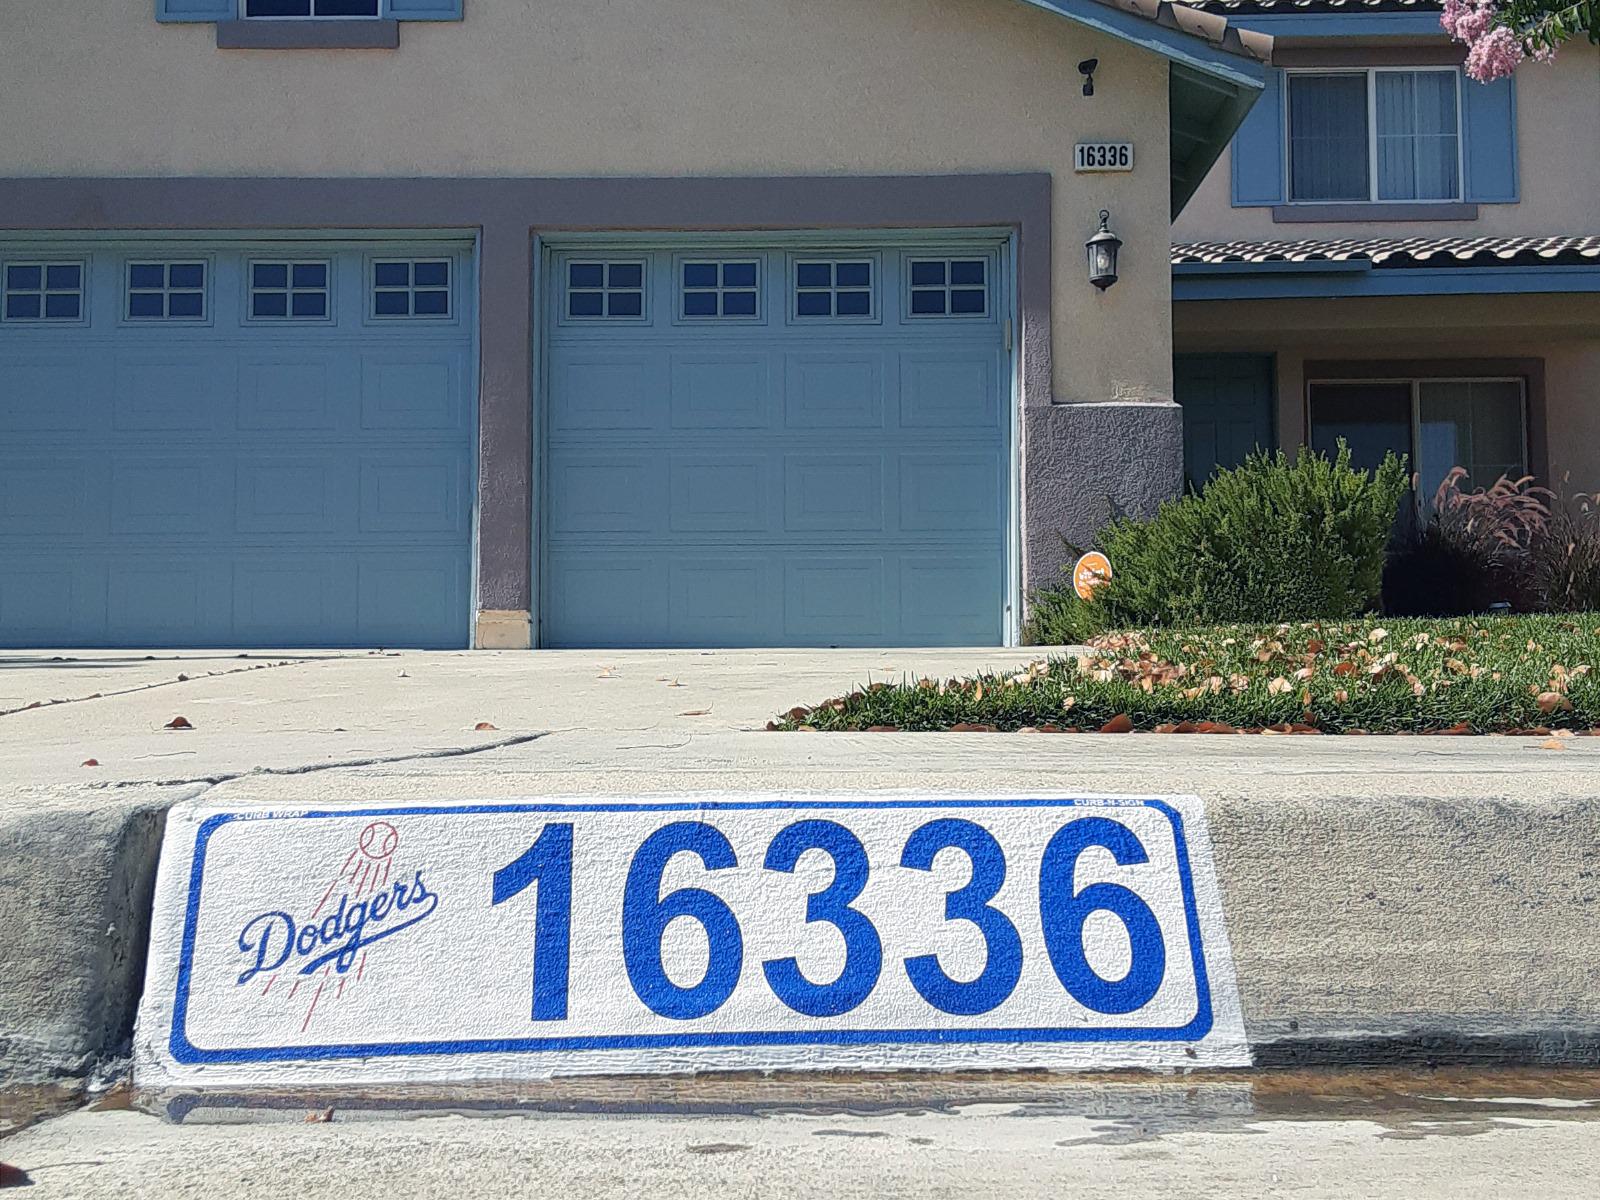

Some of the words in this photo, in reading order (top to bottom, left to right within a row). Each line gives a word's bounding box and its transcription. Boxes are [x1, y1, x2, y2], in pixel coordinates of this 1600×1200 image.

[1079, 146, 1128, 166] 16336
[237, 870, 438, 985] Dodgers
[492, 816, 1166, 1022] 16336
